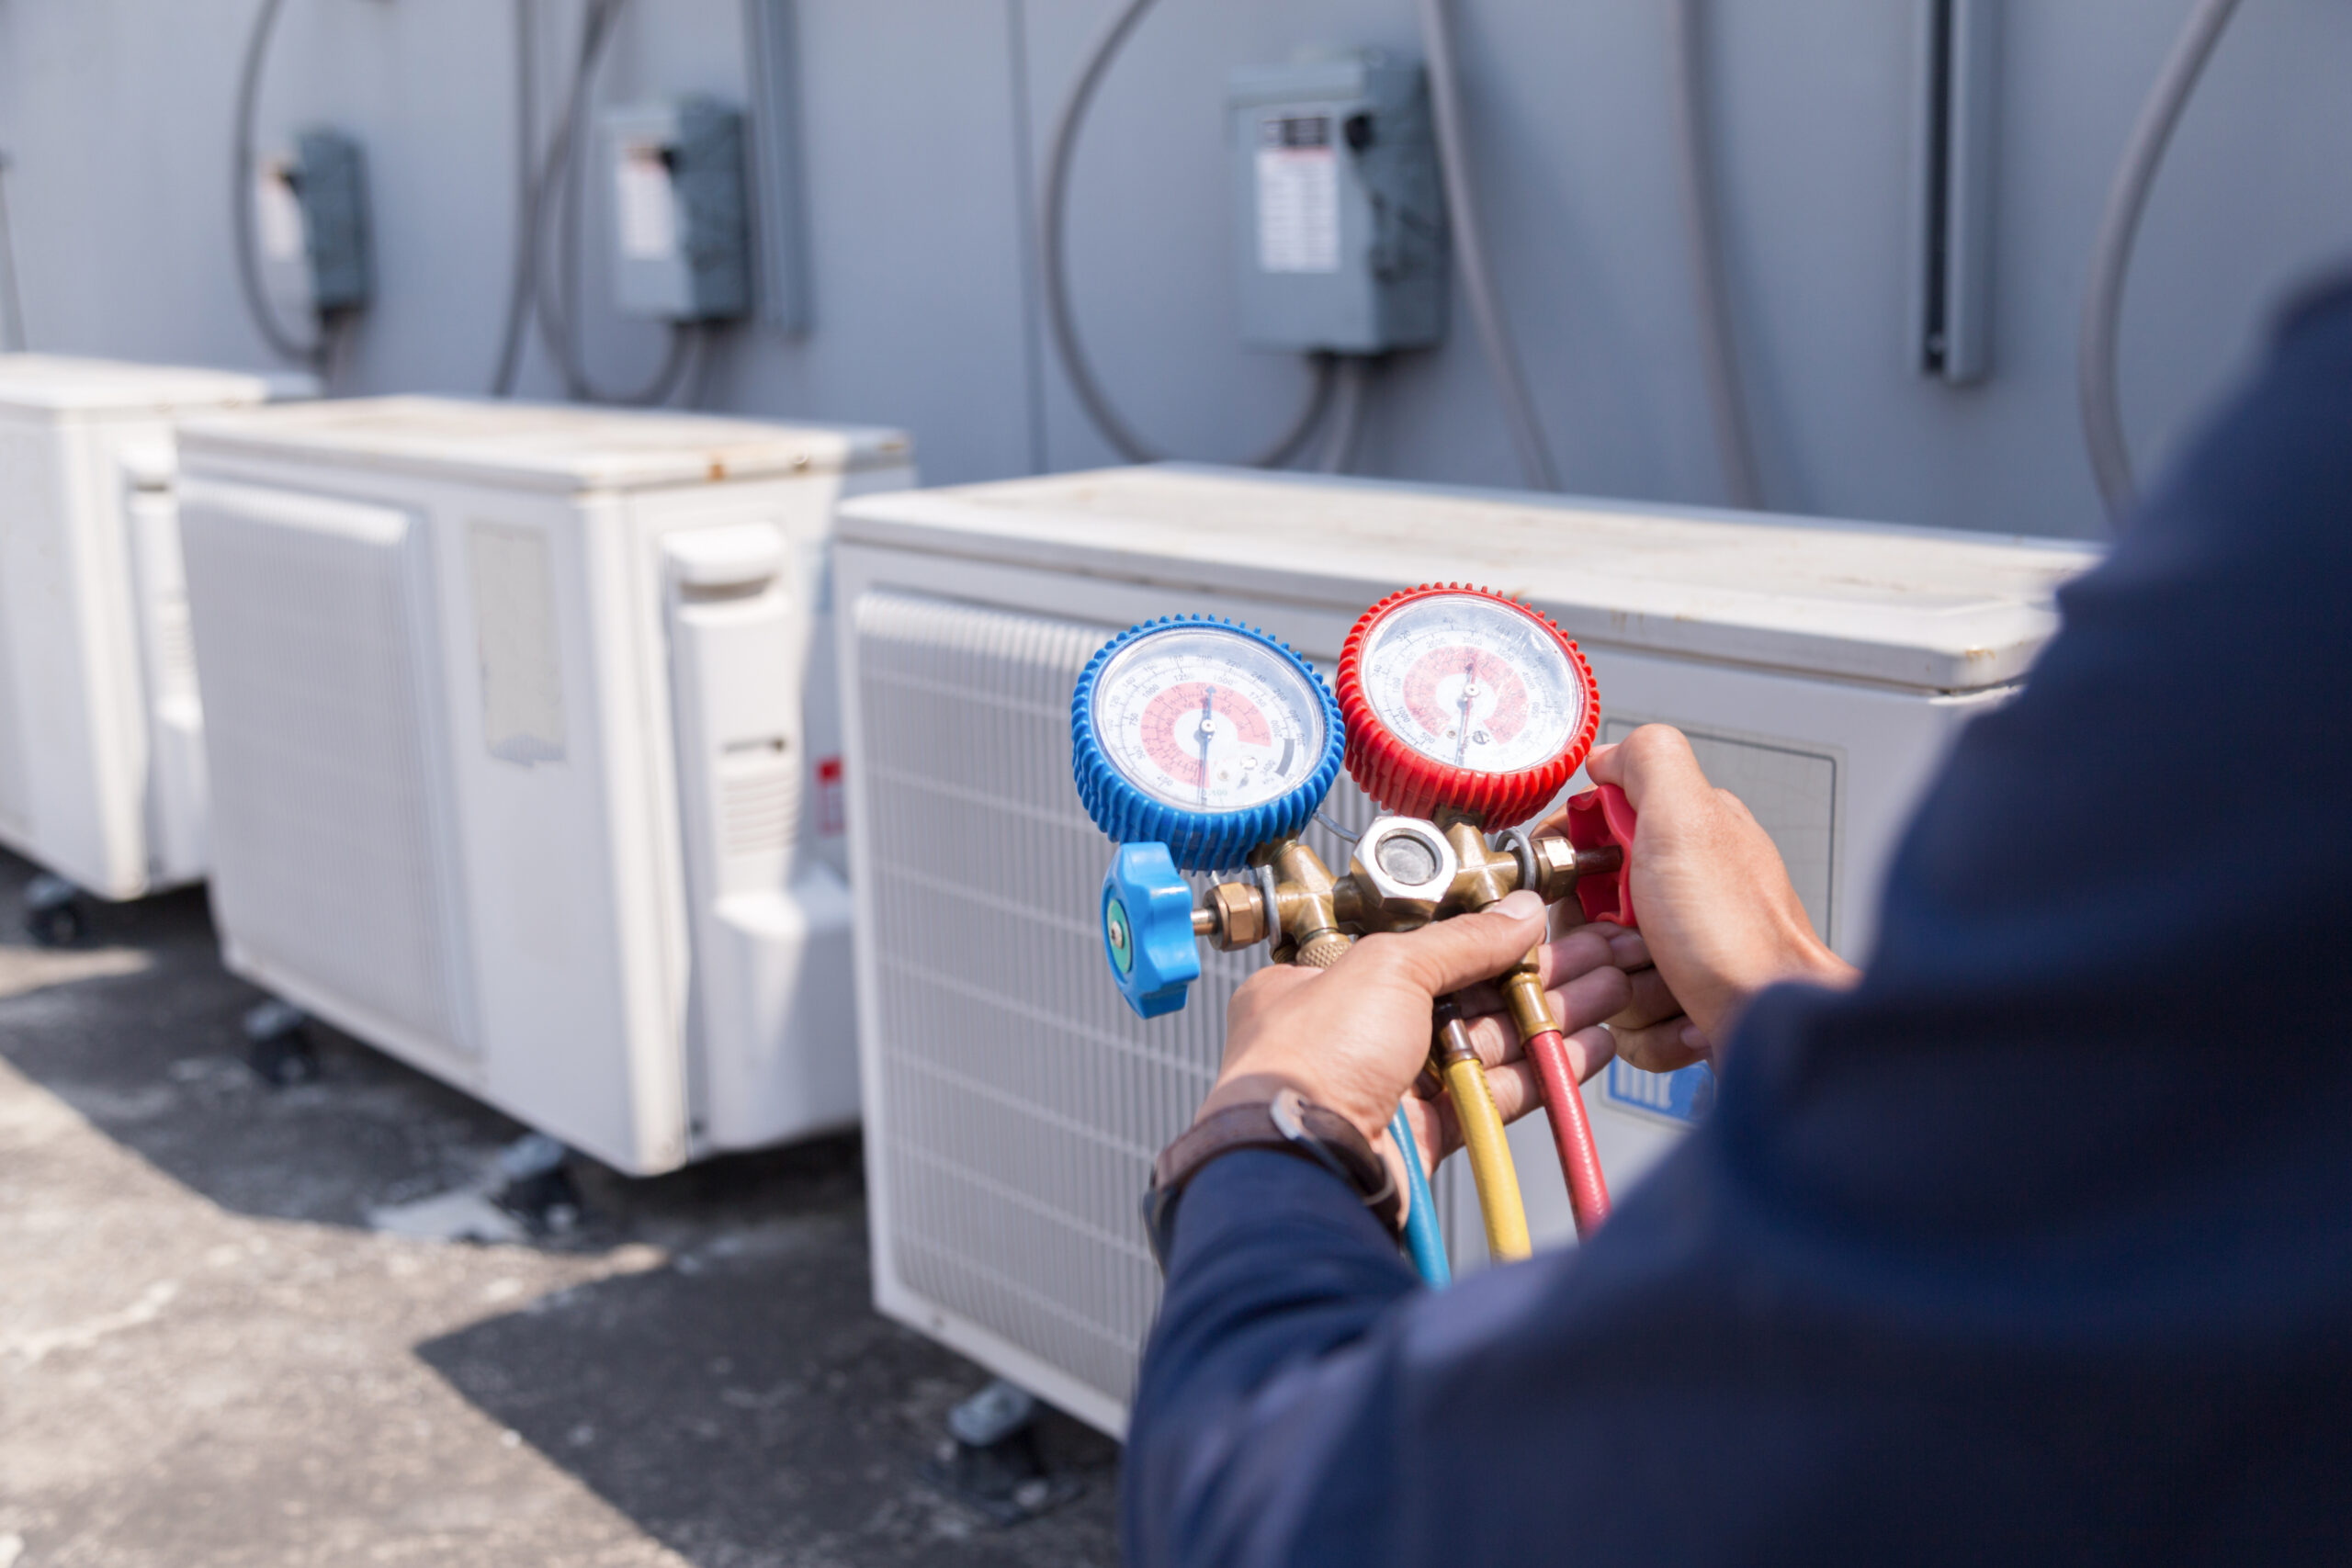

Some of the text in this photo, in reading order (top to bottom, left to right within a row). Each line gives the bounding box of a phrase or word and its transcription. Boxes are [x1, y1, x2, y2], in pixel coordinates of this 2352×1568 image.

[1225, 659, 1242, 670] 220
[1250, 671, 1267, 683] 240
[1142, 683, 1160, 698] 1000
[1249, 691, 1267, 707] 1750
[1129, 713, 1139, 726] 750
[1396, 705, 1411, 723] 1000
[1419, 732, 1435, 744] 500
